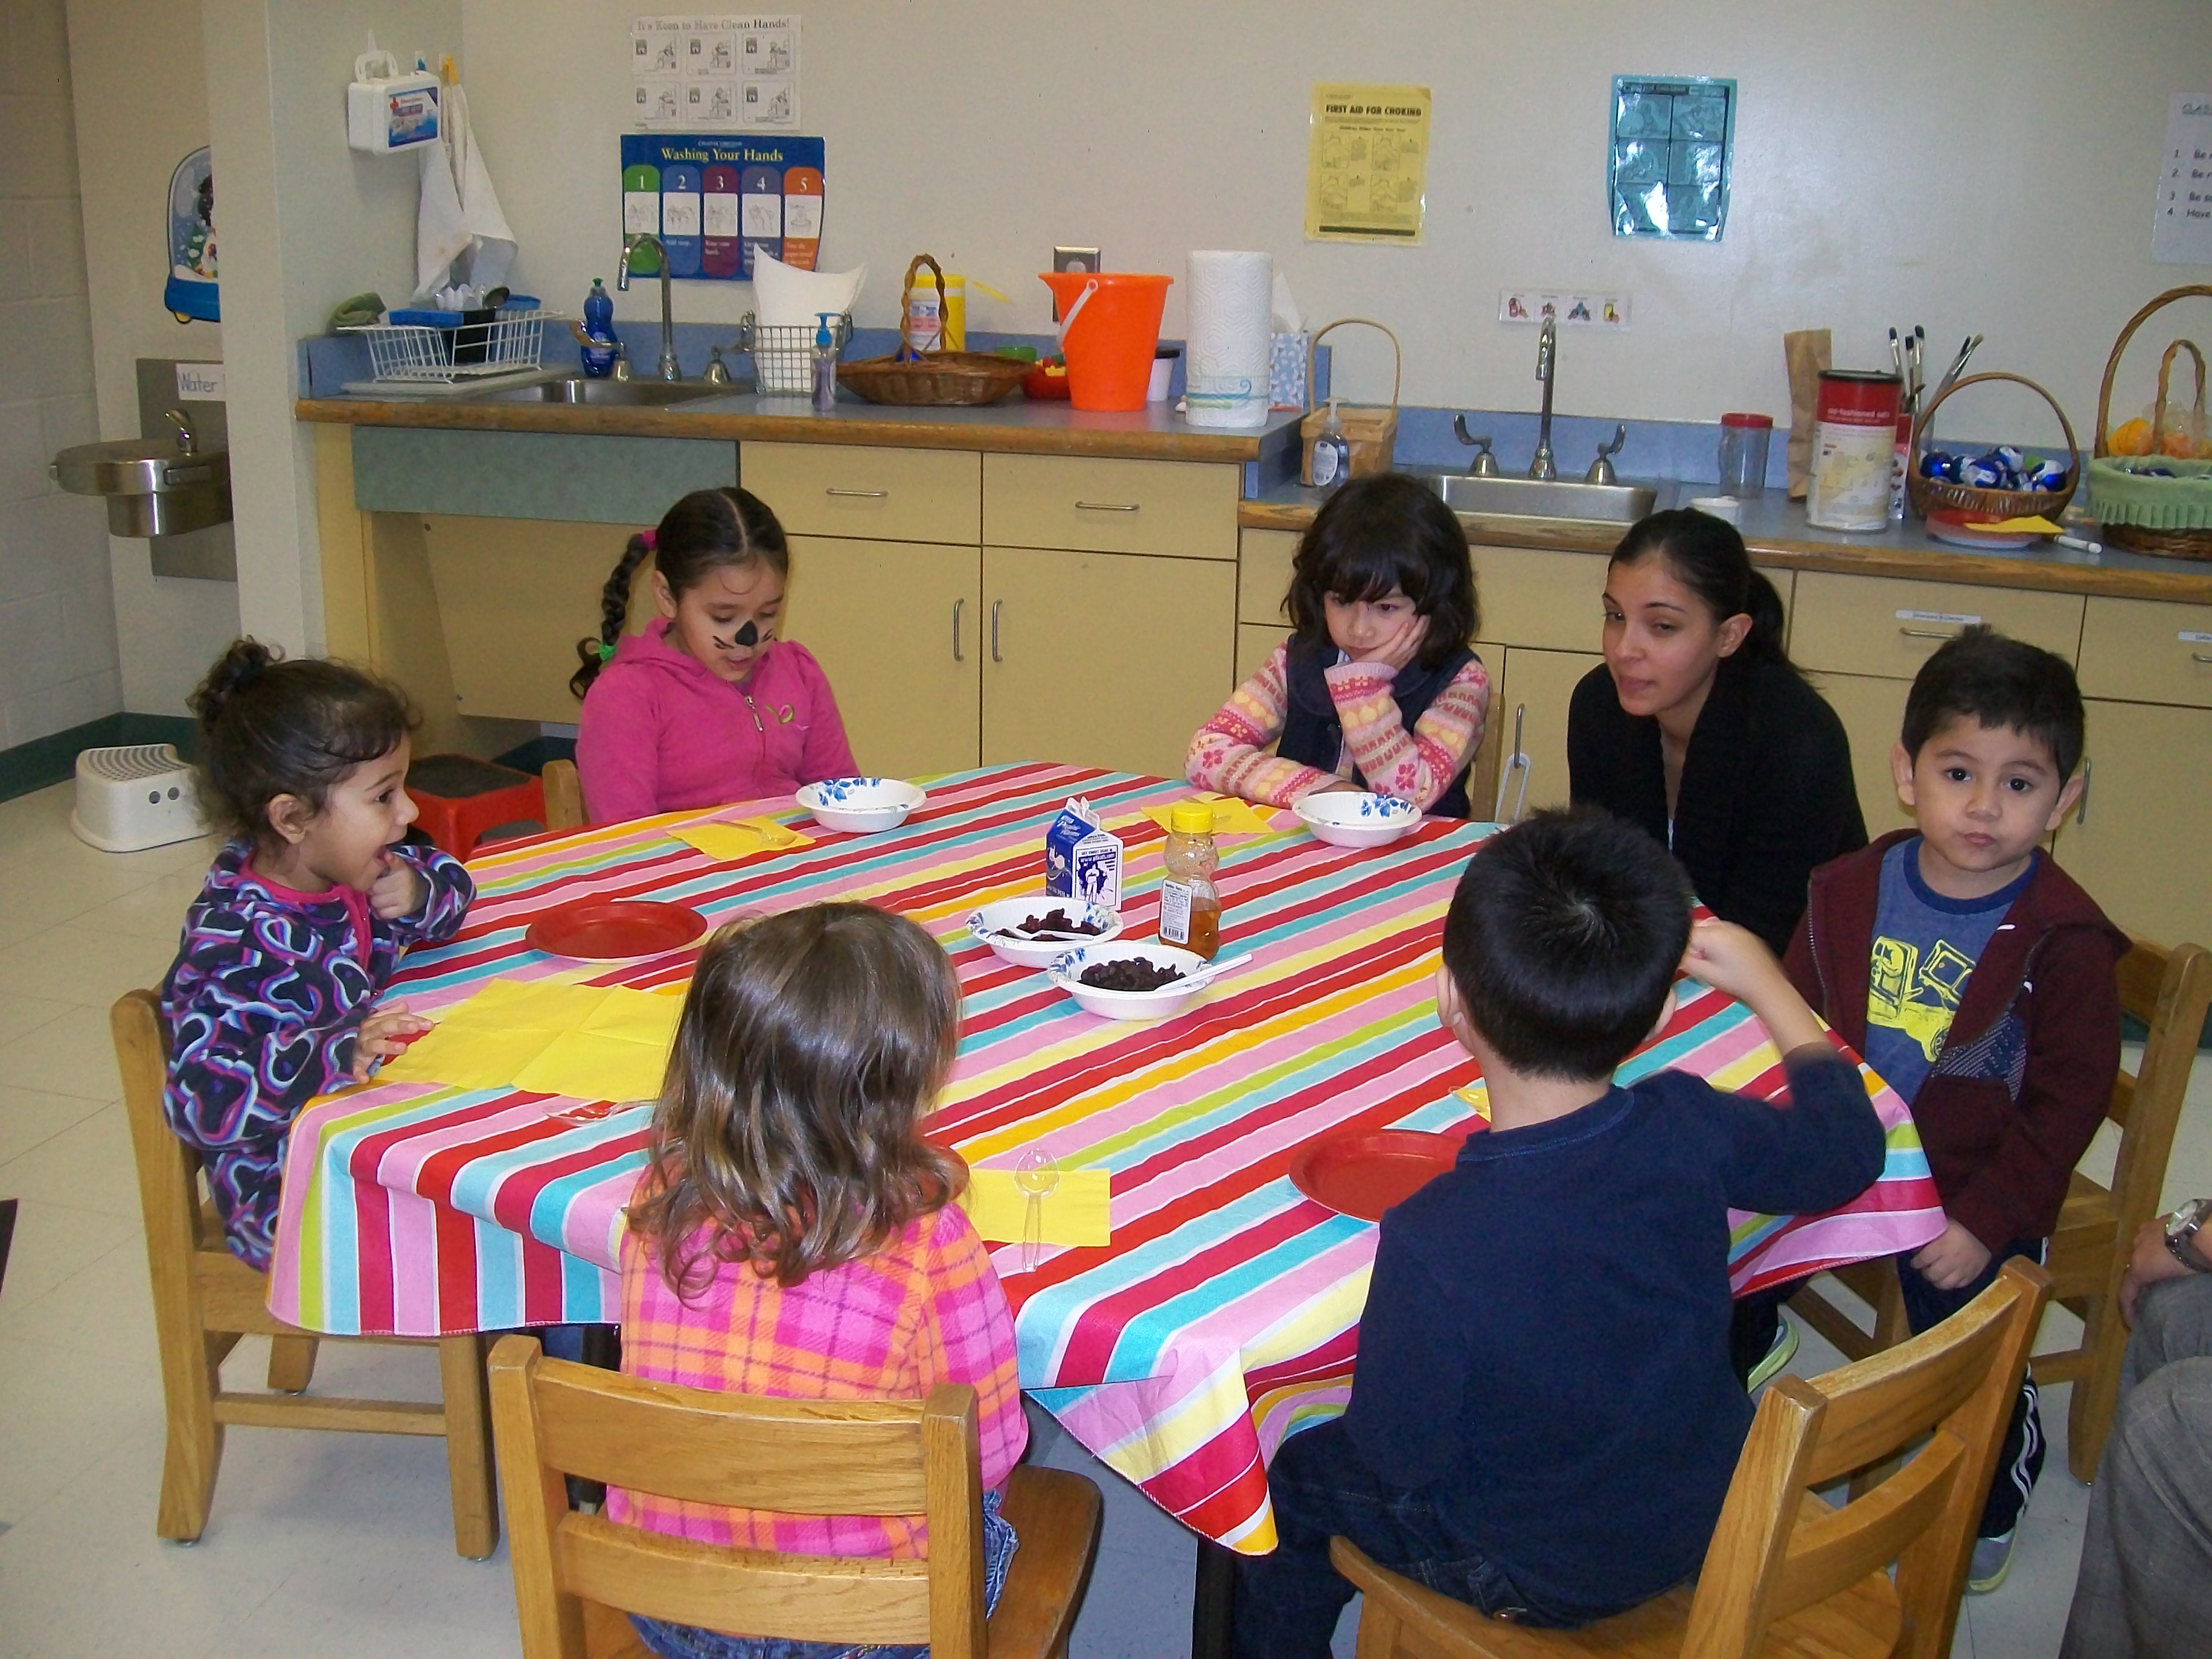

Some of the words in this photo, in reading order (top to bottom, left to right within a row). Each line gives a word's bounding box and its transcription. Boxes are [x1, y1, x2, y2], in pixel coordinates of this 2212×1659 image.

[694, 19, 718, 30] Have
[721, 19, 750, 29] Clean
[754, 18, 790, 29] Hands!
[1326, 104, 1347, 113] FIRST
[1349, 105, 1364, 114] AID
[1366, 106, 1382, 115] FOR
[1384, 106, 1422, 117] CHOKING
[661, 147, 709, 163] Washing
[712, 148, 740, 161] Your
[744, 149, 784, 162] Hands
[639, 174, 645, 190] 1
[677, 174, 687, 190] 2
[716, 175, 724, 191] 3
[756, 176, 766, 192] 4
[799, 177, 808, 193] 5
[178, 371, 218, 392] Water
